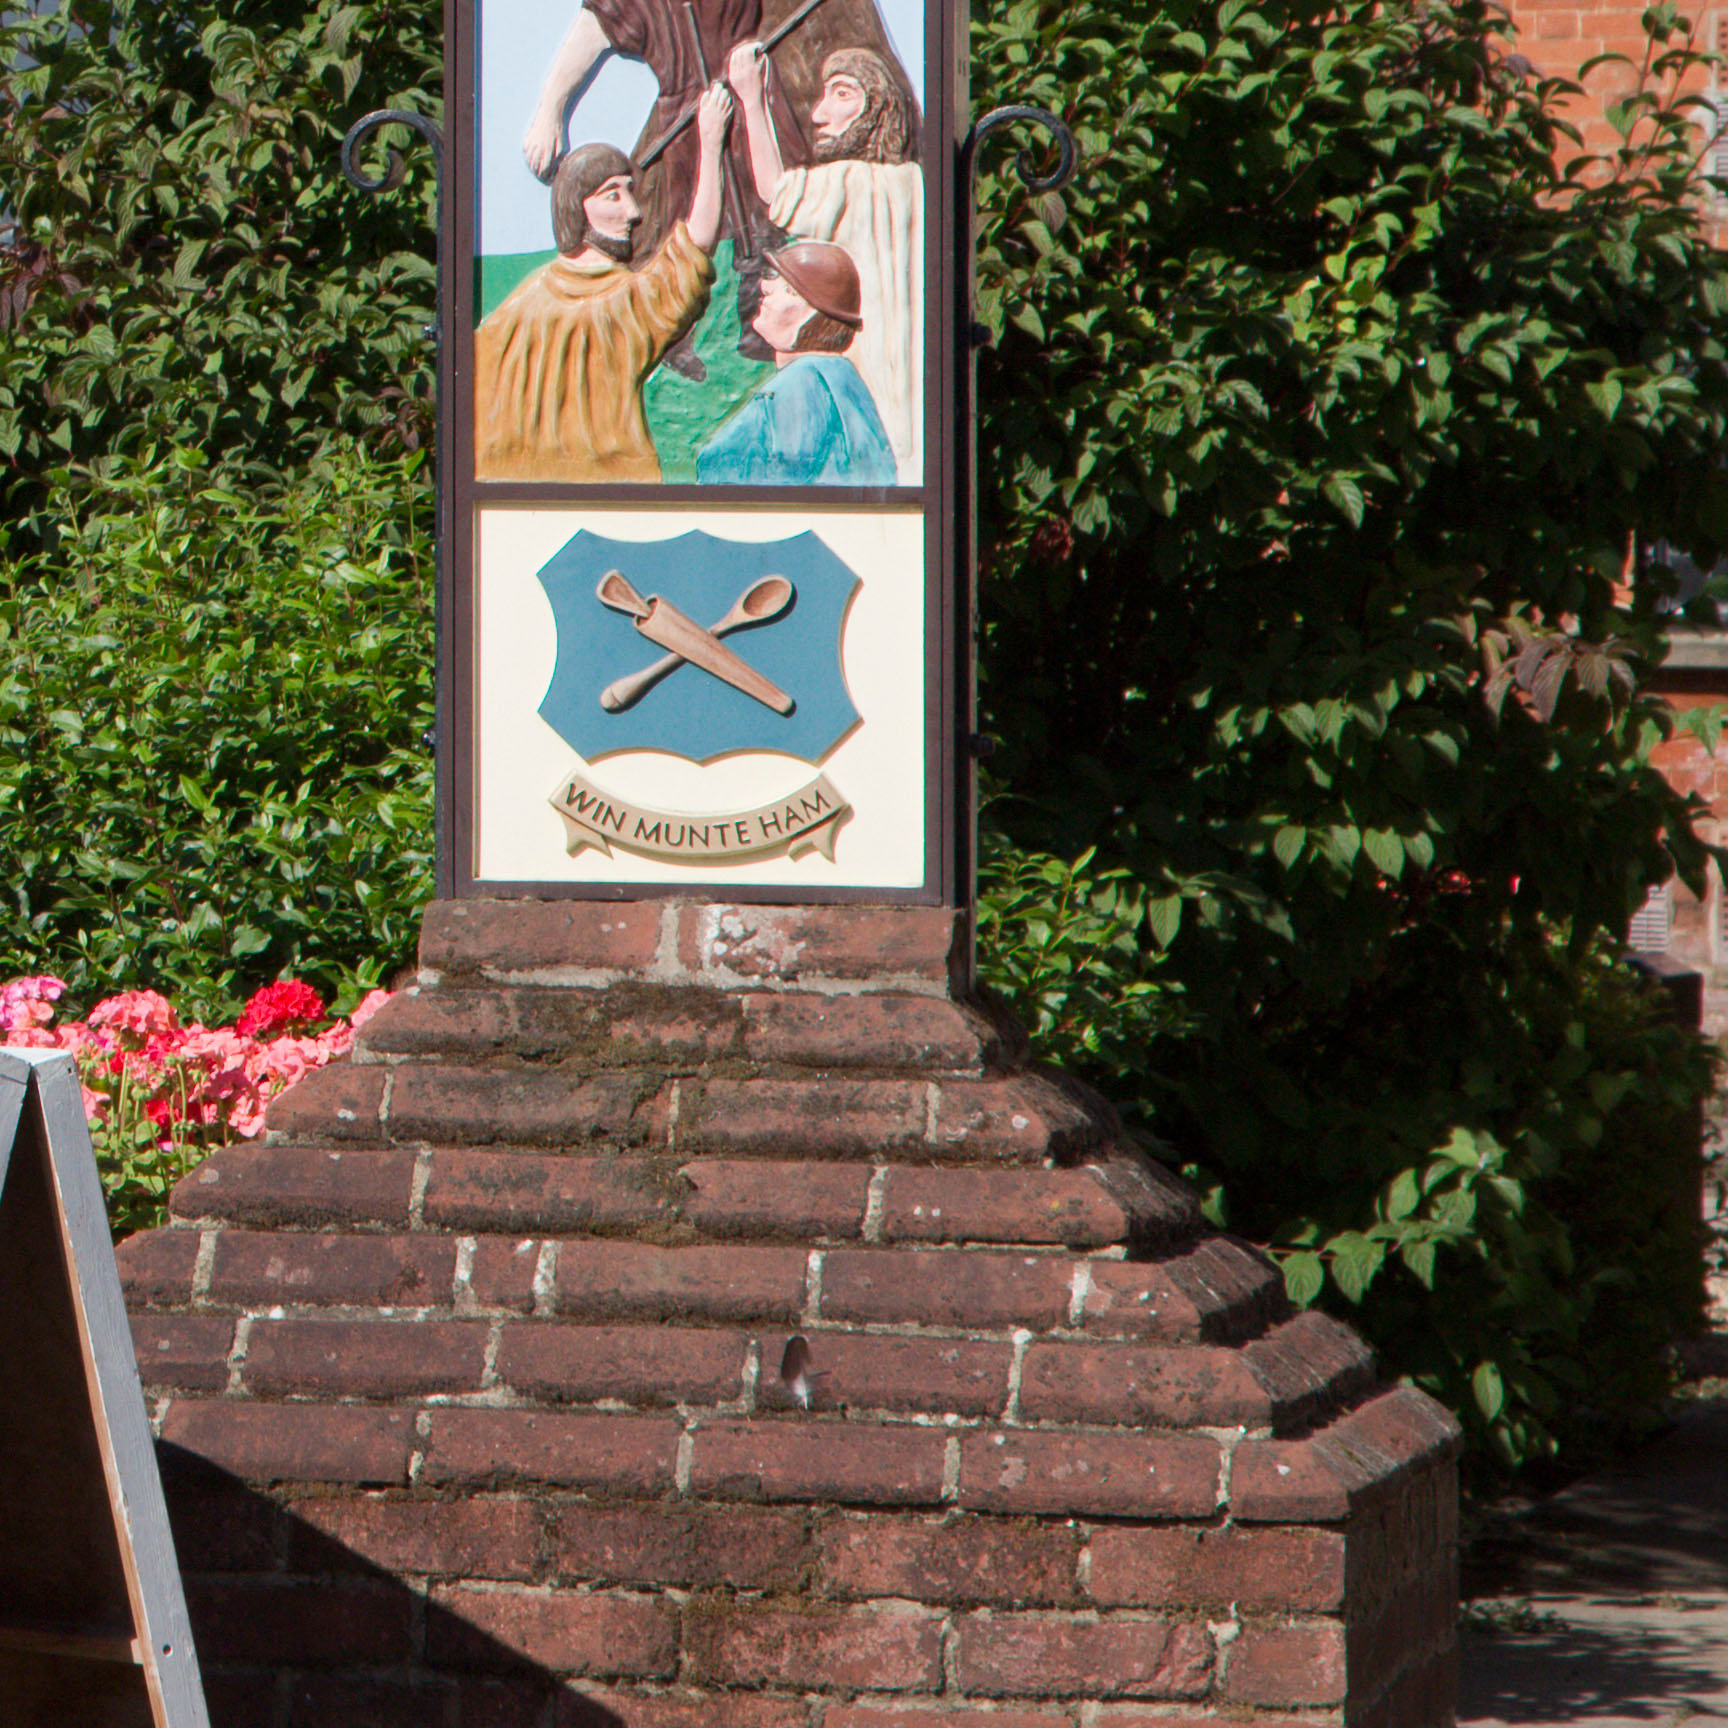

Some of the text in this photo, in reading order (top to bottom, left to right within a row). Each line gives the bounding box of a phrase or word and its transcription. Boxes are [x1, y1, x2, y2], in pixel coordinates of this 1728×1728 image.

[564, 782, 832, 848] WIN MUNTE HAM
